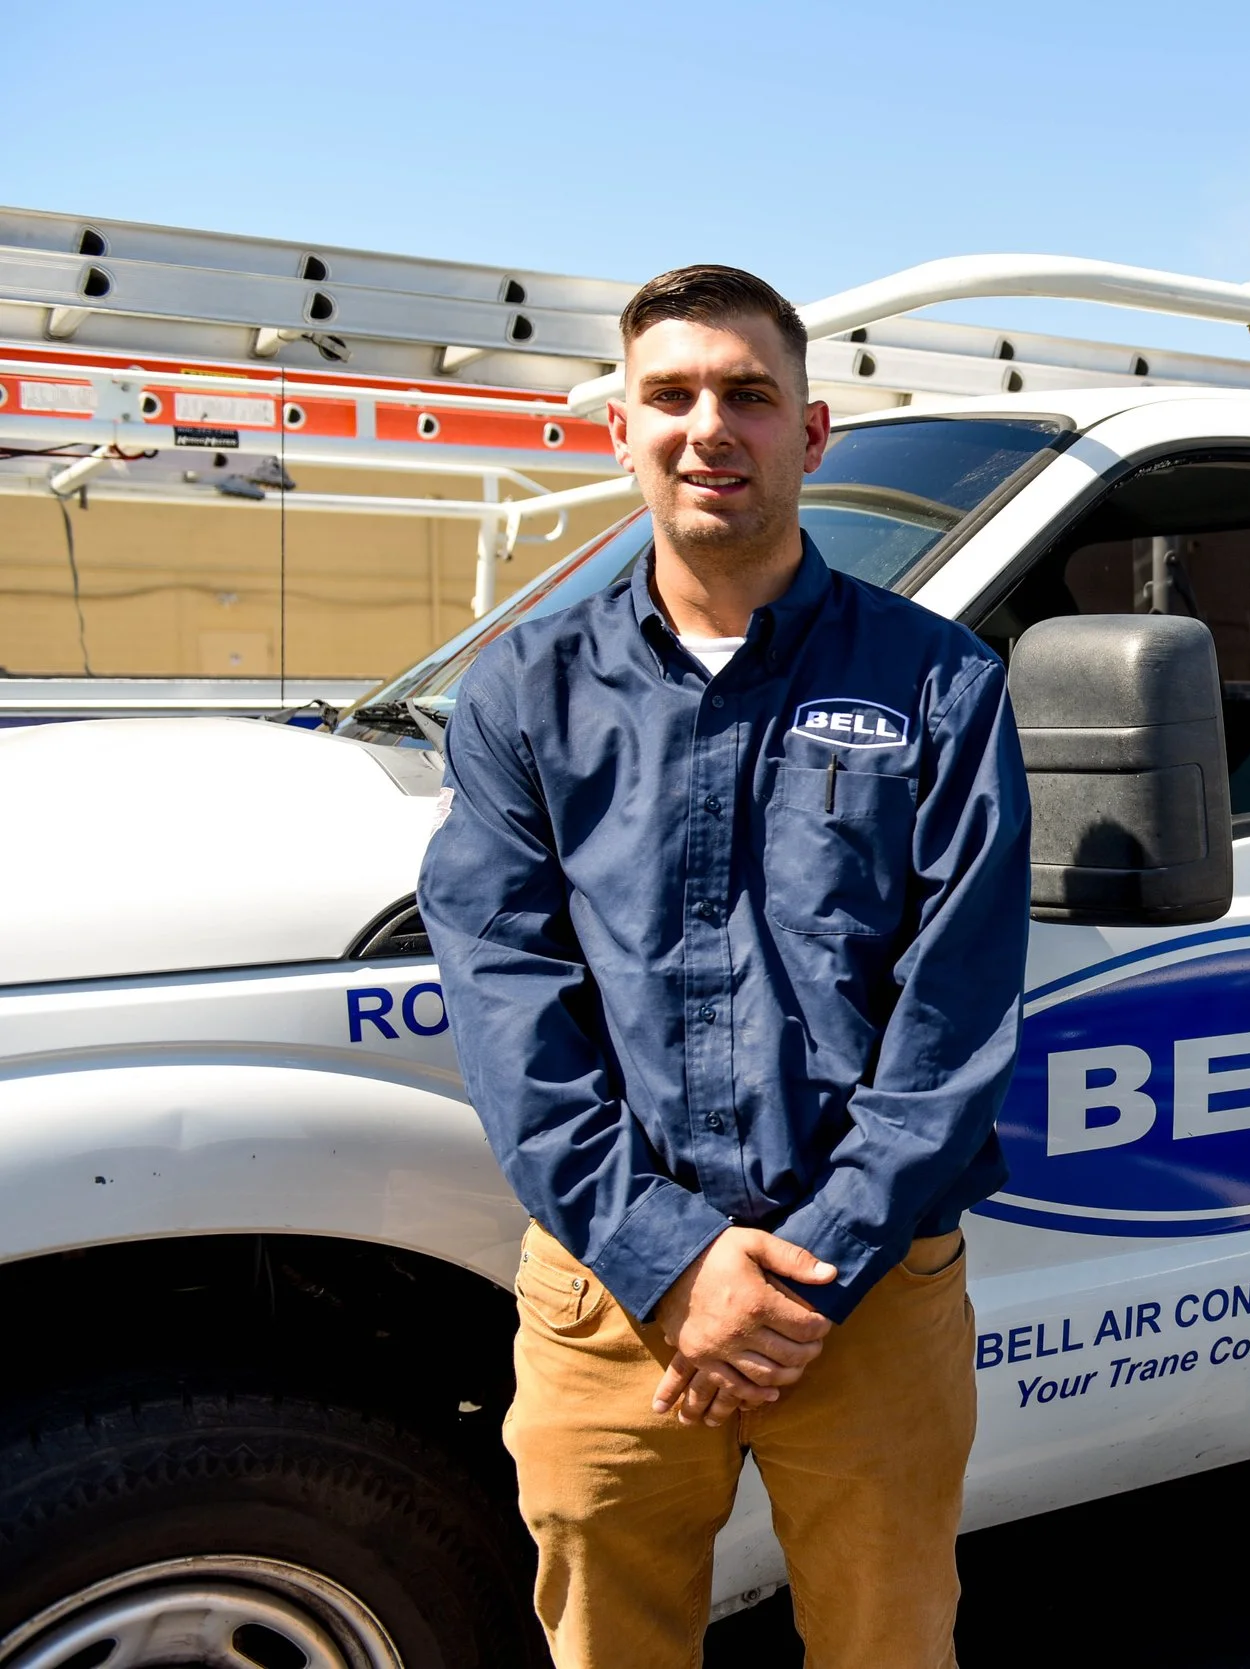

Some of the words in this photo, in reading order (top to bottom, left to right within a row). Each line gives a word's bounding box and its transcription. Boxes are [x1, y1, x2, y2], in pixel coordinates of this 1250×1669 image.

[805, 711, 897, 738] BELL
[976, 1318, 1084, 1370] BELL
[1093, 1302, 1162, 1346] AIR
[1017, 1370, 1098, 1408] Your
[1109, 1350, 1198, 1389] Trane
